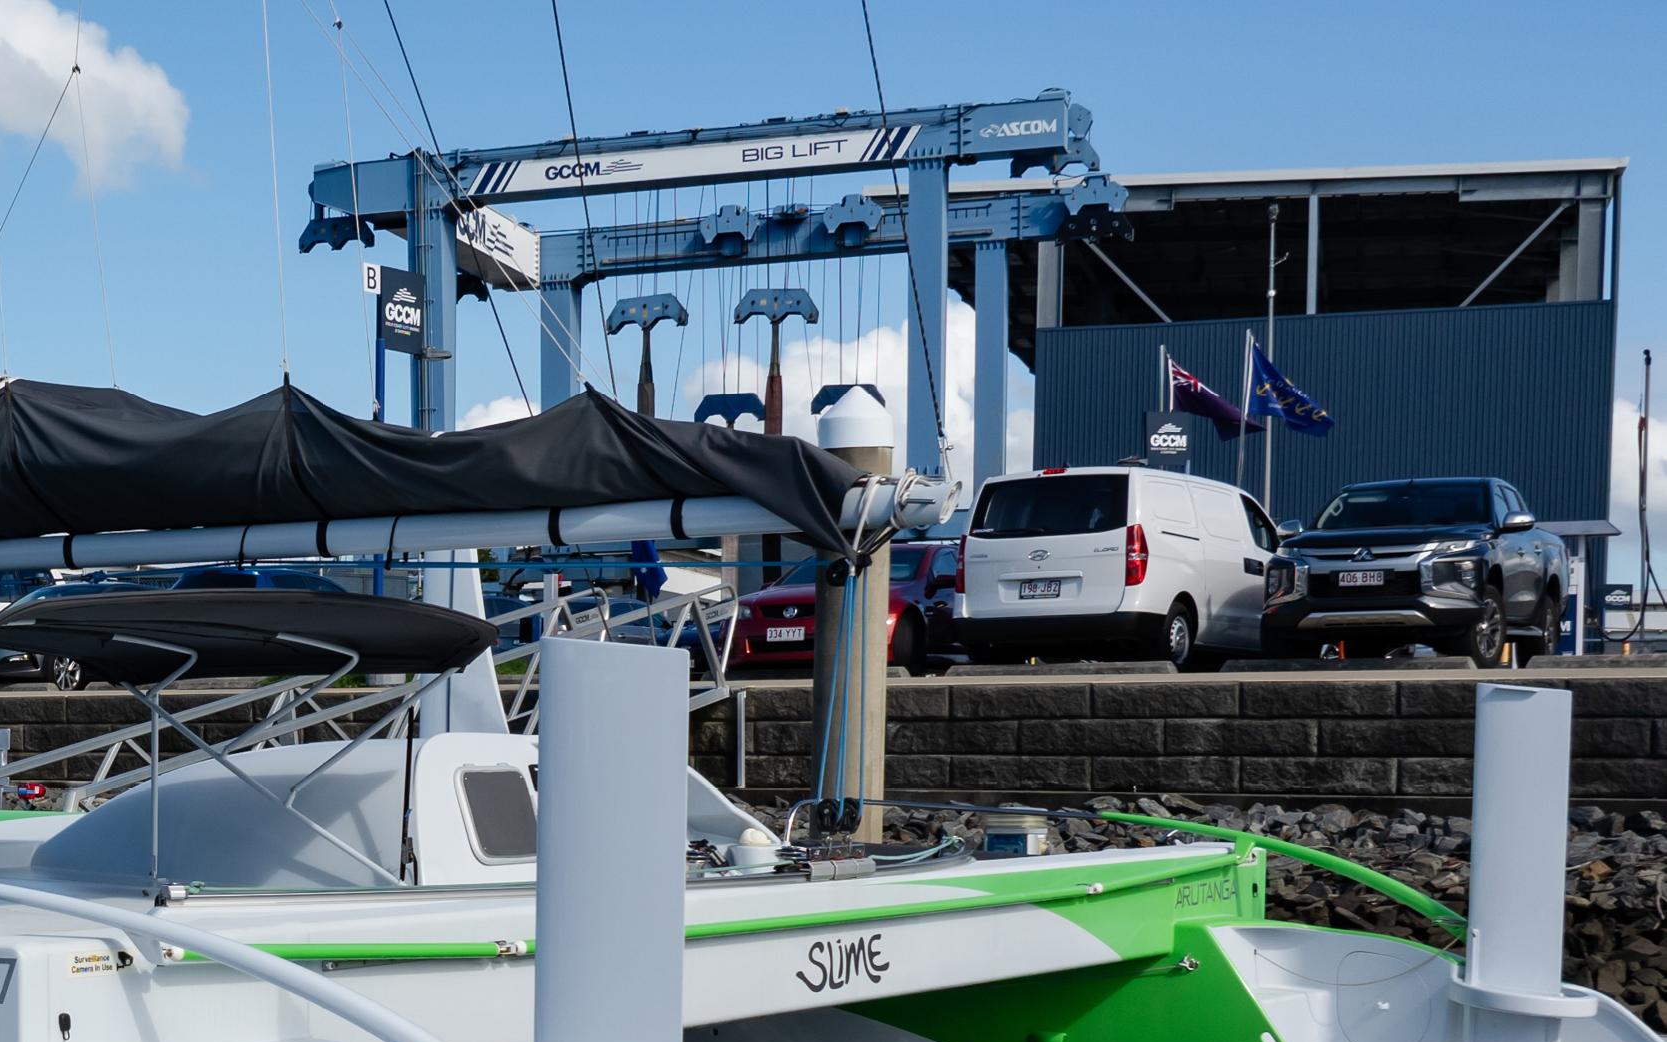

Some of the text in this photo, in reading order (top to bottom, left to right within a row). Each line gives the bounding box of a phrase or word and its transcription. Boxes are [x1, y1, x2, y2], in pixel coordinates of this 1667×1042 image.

[996, 119, 1057, 137] ASCOM
[545, 139, 848, 180] GCCM BIG LIFT
[367, 266, 377, 290] B
[384, 302, 421, 327] GCCM
[1150, 434, 1188, 447] GCCM
[1175, 880, 1237, 910] ARUTANGA
[102, 963, 113, 971] Use
